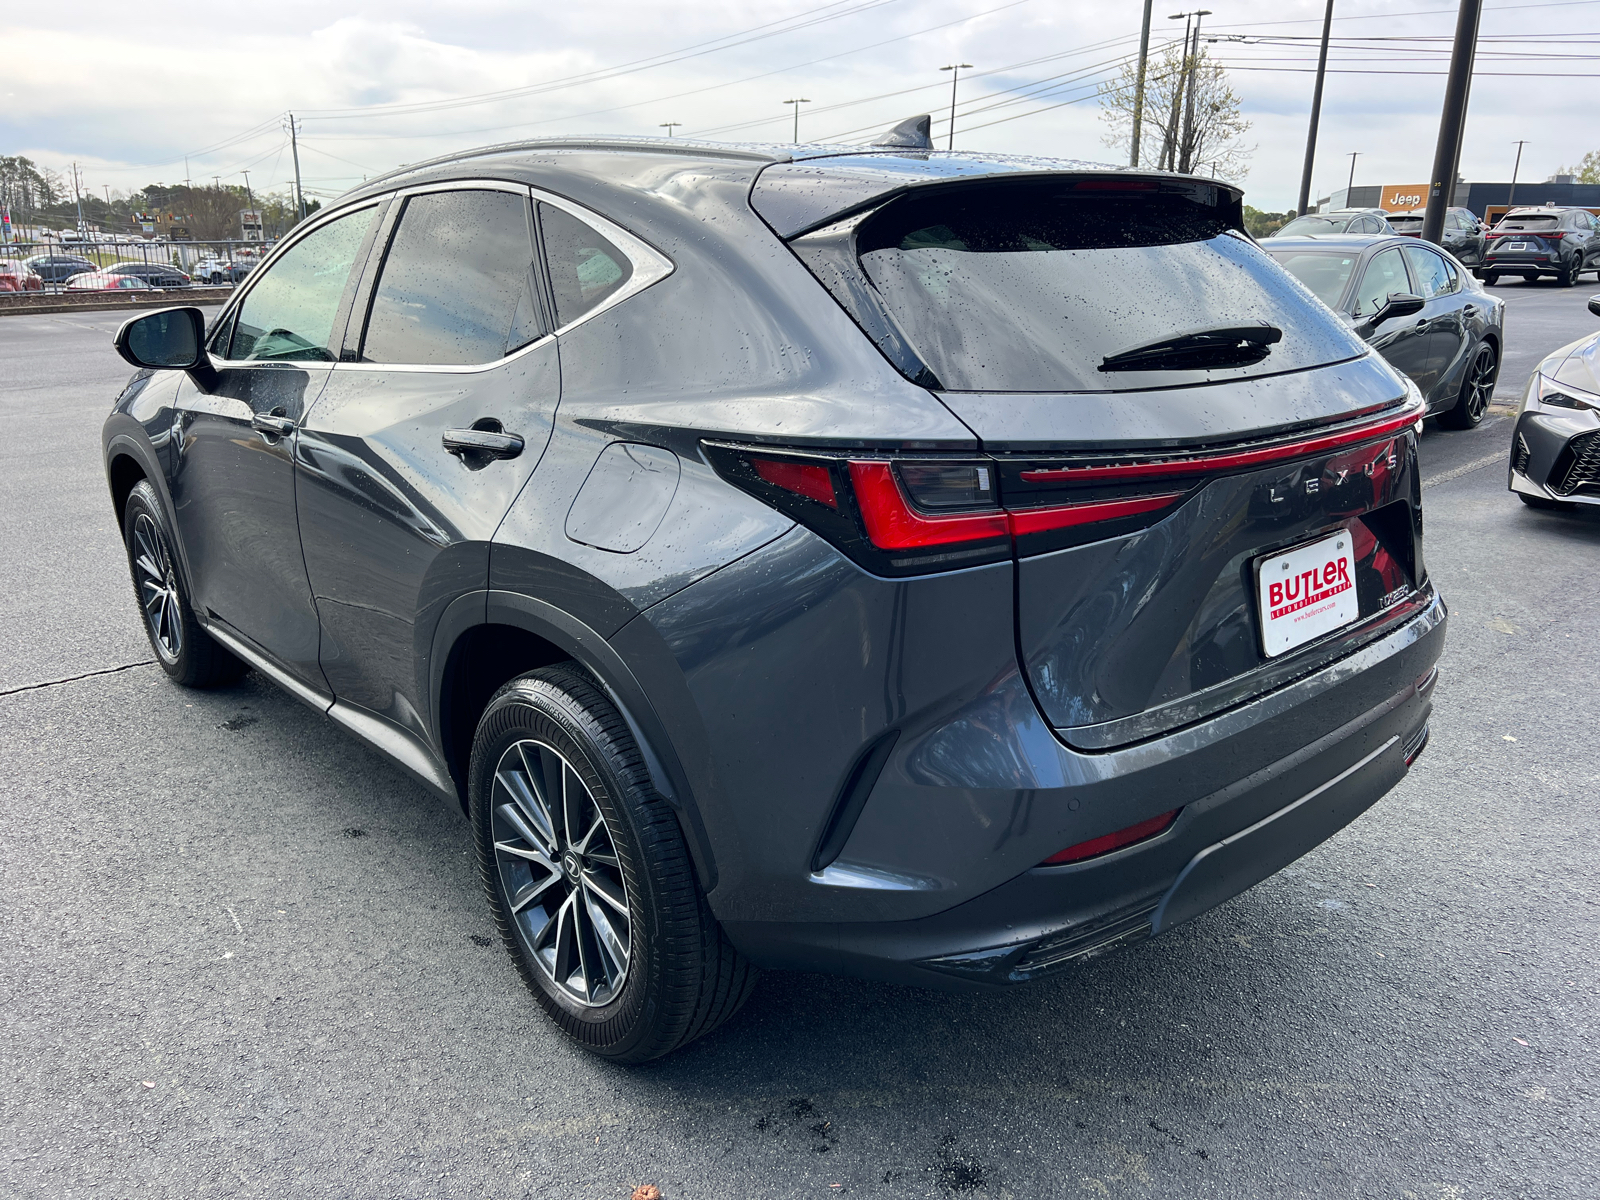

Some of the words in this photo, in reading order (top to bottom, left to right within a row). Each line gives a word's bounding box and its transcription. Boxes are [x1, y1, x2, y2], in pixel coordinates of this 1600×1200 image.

[1390, 192, 1421, 207] Jeep
[1269, 454, 1397, 503] LEXUS
[1270, 593, 1322, 619] AUTOMOTIVE
[1328, 581, 1350, 596] GROUP
[1293, 601, 1336, 623] www.butlercars.com
[531, 694, 579, 737] BRIDGESTONE
